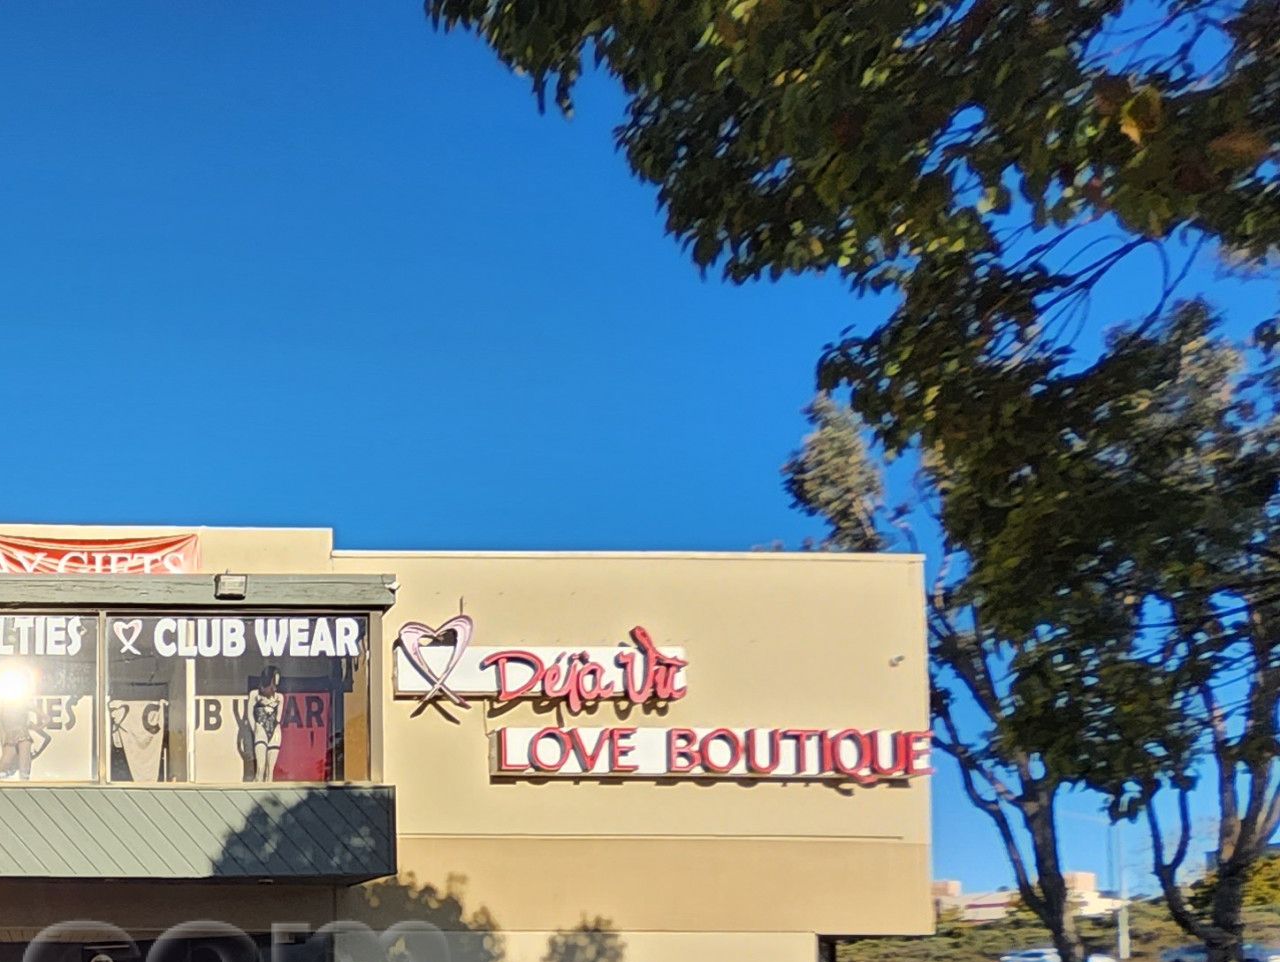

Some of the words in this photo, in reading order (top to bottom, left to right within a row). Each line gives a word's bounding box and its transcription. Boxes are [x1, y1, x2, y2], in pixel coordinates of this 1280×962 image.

[57, 551, 185, 574] GIFTS
[154, 617, 246, 658] CLUB
[254, 617, 360, 658] WEAR
[617, 625, 690, 702] Vu
[498, 728, 640, 774] LOVE
[665, 728, 934, 785] BOUTIQUE
